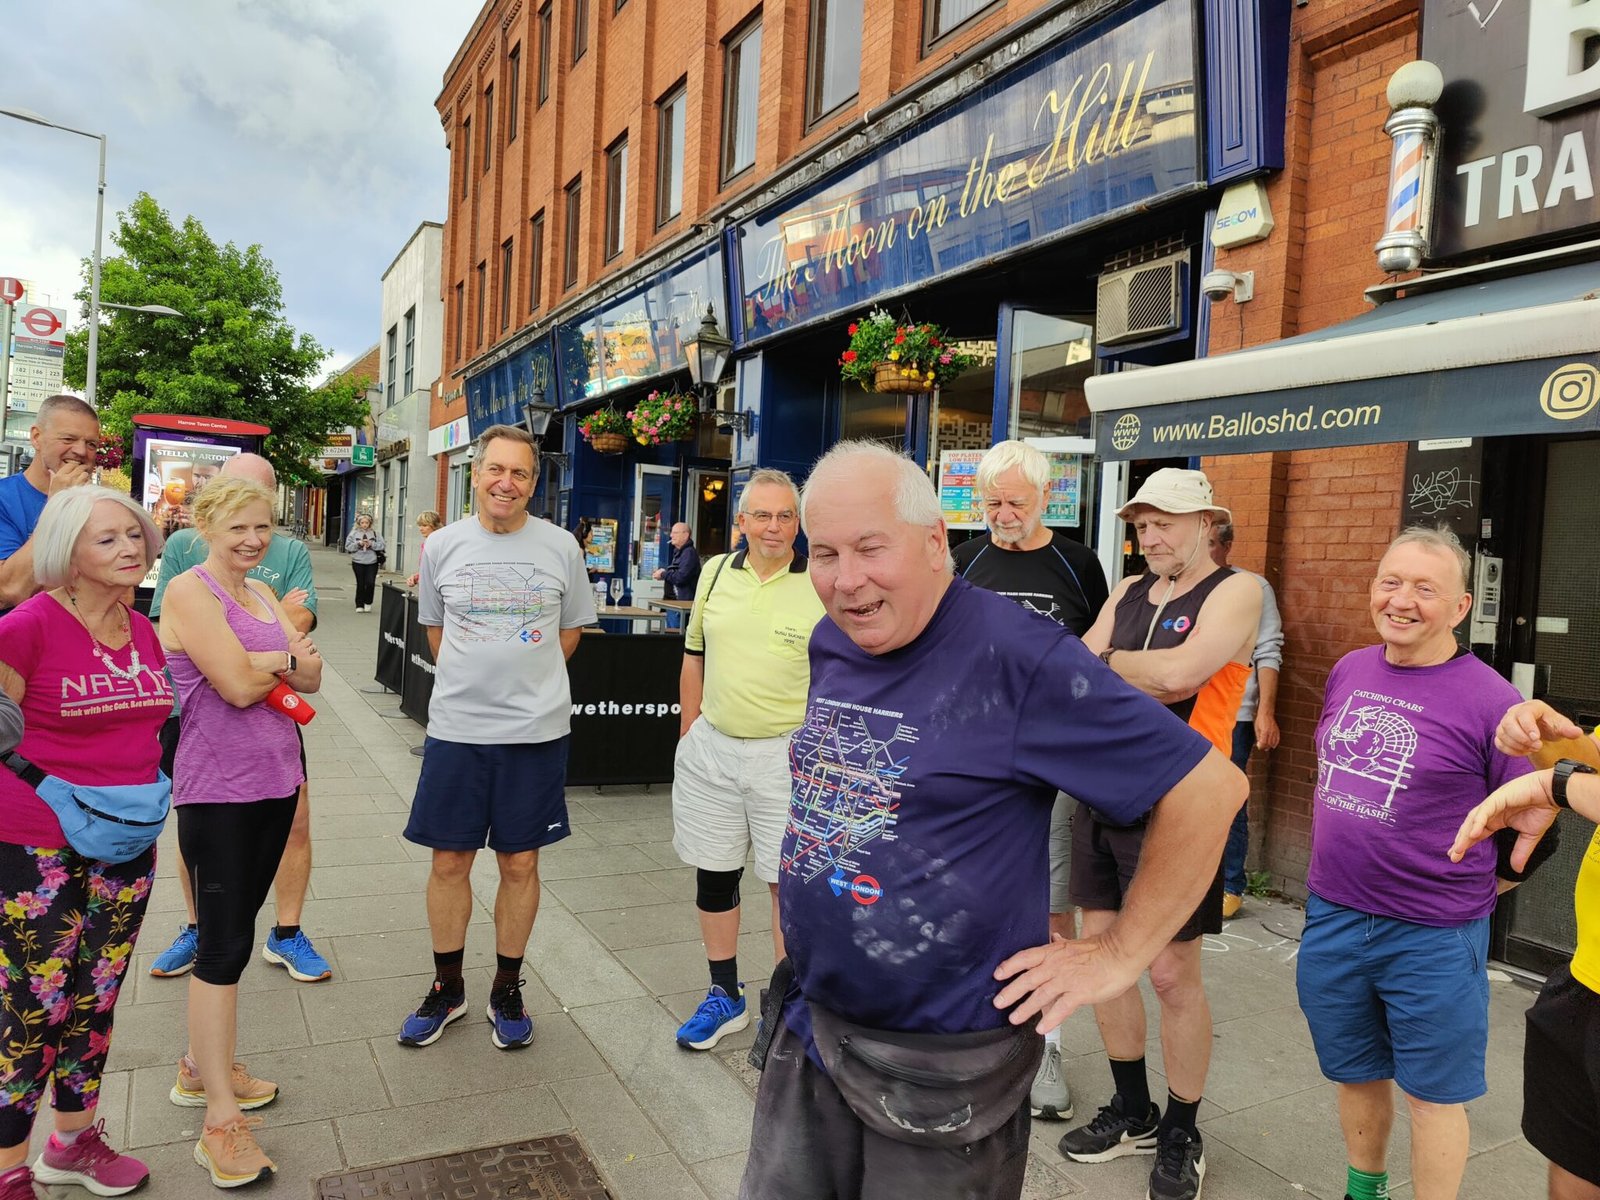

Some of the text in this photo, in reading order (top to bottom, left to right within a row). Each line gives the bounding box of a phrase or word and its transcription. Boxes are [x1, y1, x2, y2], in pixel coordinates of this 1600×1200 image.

[758, 49, 1156, 302] The Moon on the Hill
[1456, 131, 1594, 227] TRA
[1216, 207, 1257, 230] SECOM
[1113, 426, 1141, 437] www
[1152, 404, 1381, 443] www.Balloshd.com
[157, 449, 189, 458] STELLA
[61, 708, 82, 717] Drink
[83, 705, 101, 715] with
[102, 703, 113, 712] the
[571, 701, 681, 717] wetherspo
[852, 703, 873, 713] HOUSE
[873, 707, 904, 718] HARRIERS
[1353, 690, 1424, 712] CATCHING CRABS
[1339, 799, 1356, 811] THE
[1356, 805, 1389, 820] HASH!
[830, 878, 880, 896] WEST LONDON
